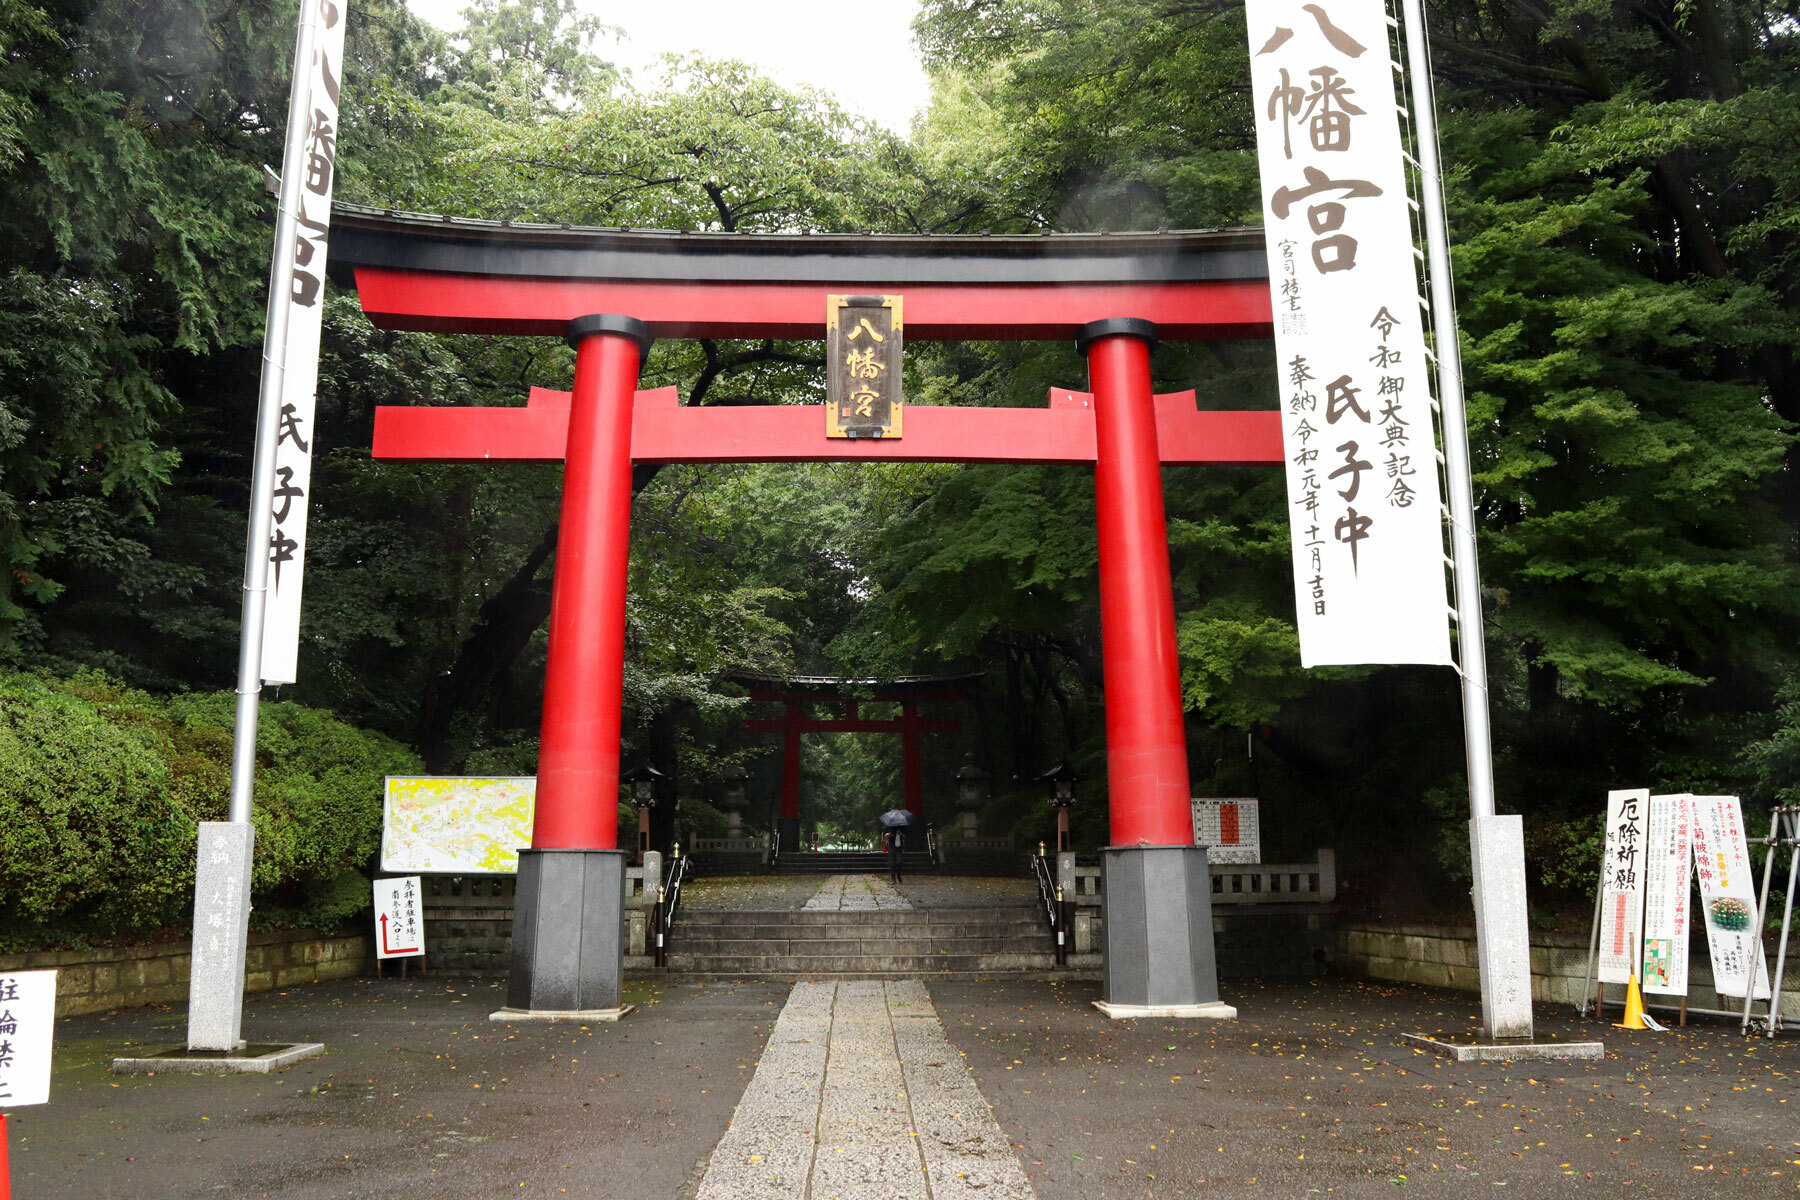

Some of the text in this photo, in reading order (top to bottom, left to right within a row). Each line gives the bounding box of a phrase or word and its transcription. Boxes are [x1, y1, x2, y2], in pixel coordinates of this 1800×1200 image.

[1255, 3, 1383, 275] 八幡宮
[846, 318, 885, 417] 八幡宮
[1369, 306, 1417, 508] 令和御大典記念
[269, 402, 309, 600] 氏子中
[1325, 374, 1373, 580] 氏子中
[1614, 798, 1641, 890] 厄除祈願
